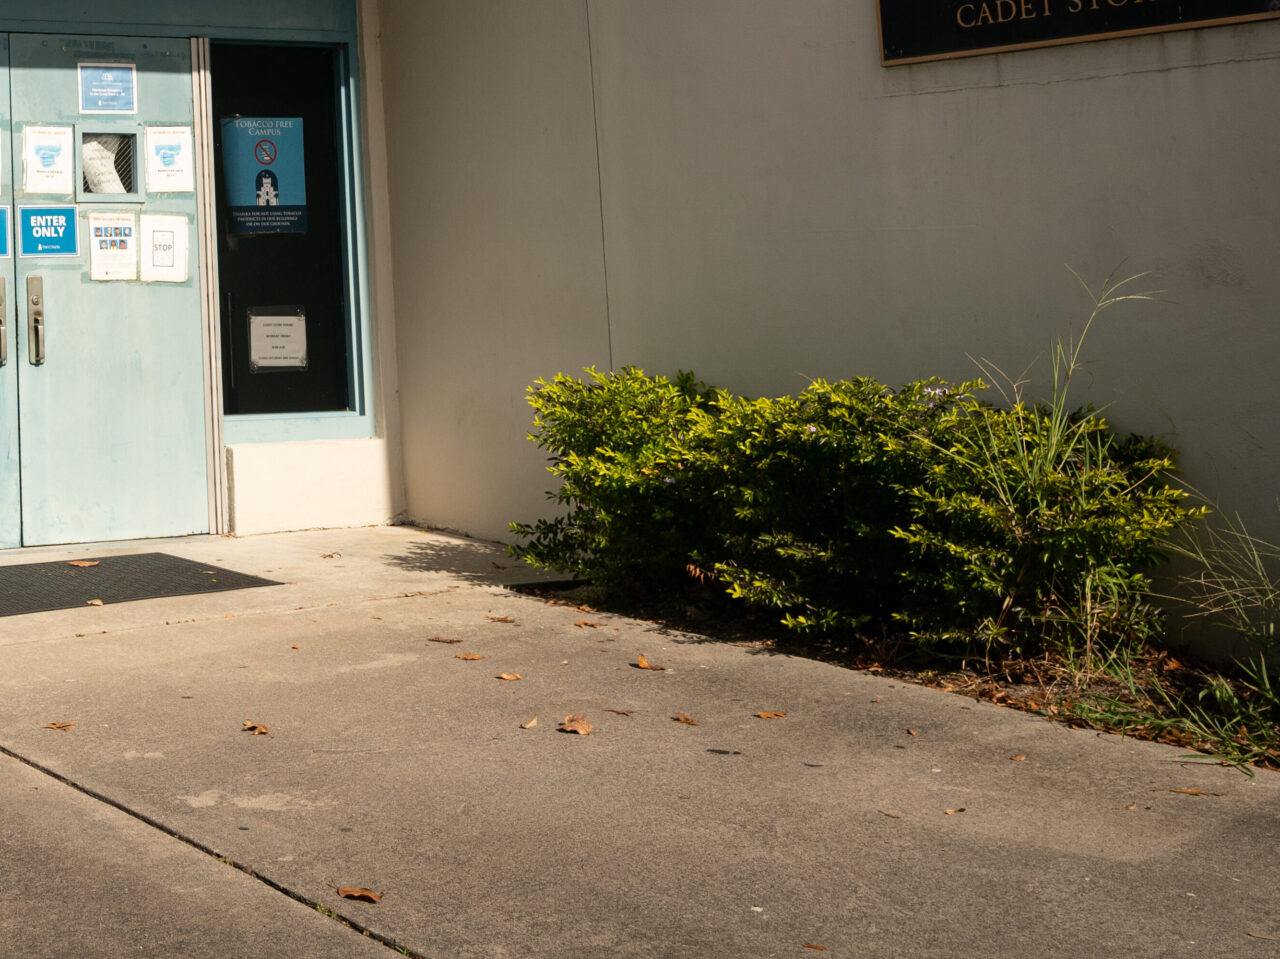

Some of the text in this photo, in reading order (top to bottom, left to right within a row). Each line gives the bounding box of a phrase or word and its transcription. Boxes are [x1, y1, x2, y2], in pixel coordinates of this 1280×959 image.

[235, 120, 294, 128] TOBACCO FREE
[248, 128, 281, 136] CAMPUS
[30, 215, 67, 226] ENTER
[32, 226, 65, 237] ONLY
[153, 243, 173, 252] STOP
